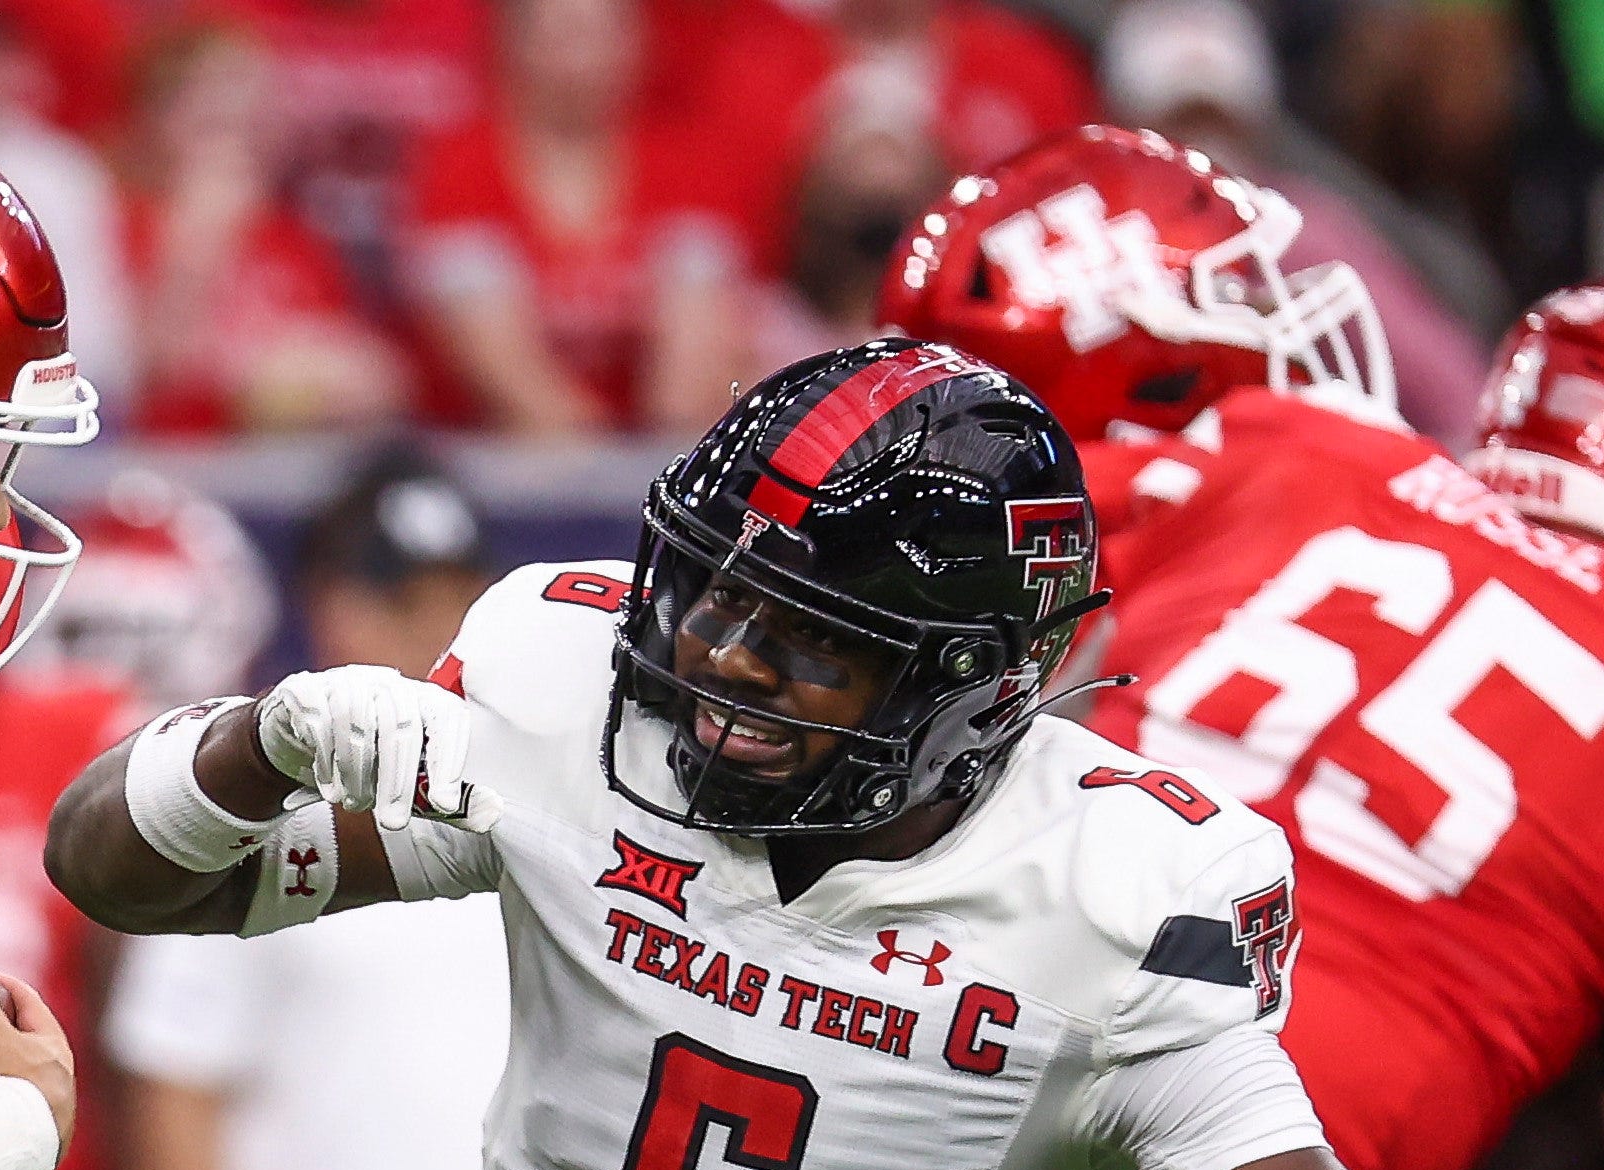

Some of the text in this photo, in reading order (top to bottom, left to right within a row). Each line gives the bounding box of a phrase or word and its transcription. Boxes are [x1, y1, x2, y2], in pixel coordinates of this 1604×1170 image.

[1139, 524, 1604, 905] 65
[1078, 766, 1222, 826] 6
[594, 828, 706, 922] XII
[604, 907, 920, 1060] TEXAS TECH
[944, 981, 1021, 1077] C
